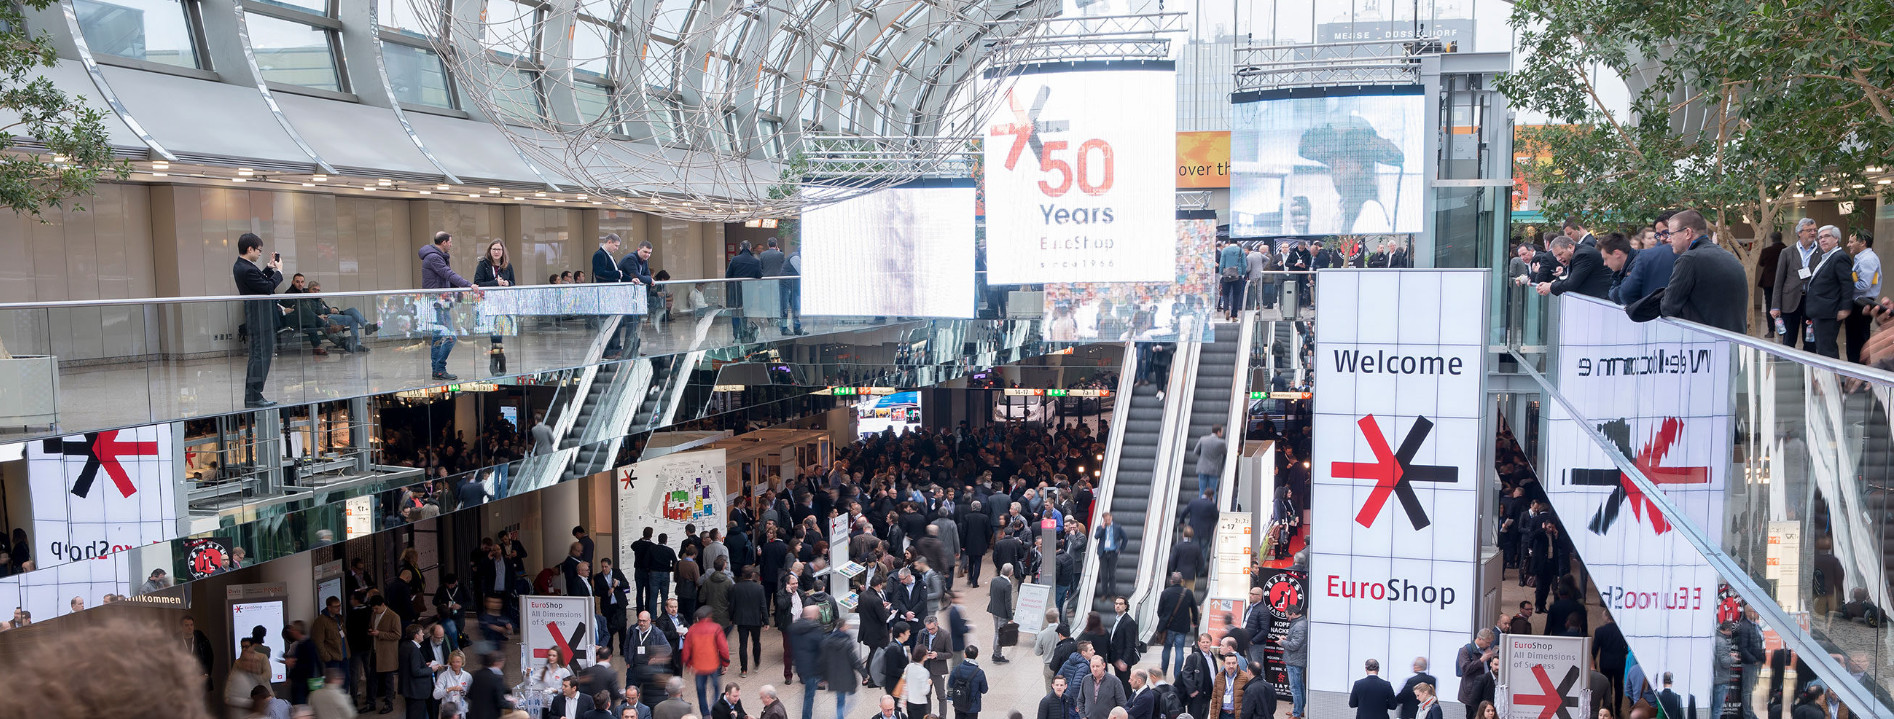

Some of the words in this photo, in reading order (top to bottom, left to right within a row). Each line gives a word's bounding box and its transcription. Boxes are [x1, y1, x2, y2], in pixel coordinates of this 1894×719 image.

[1334, 31, 1370, 40] MESSE
[1037, 138, 1114, 198] 50
[1178, 165, 1212, 177] over
[1040, 204, 1114, 225] Years
[1333, 350, 1463, 375] Welcome
[1327, 574, 1456, 610] EuroShop
[531, 601, 563, 609] EuroShop
[542, 611, 582, 619] Dimensions
[1514, 641, 1553, 651] EuroShop
[1513, 651, 1524, 659] All
[1527, 651, 1576, 661] Dimensions
